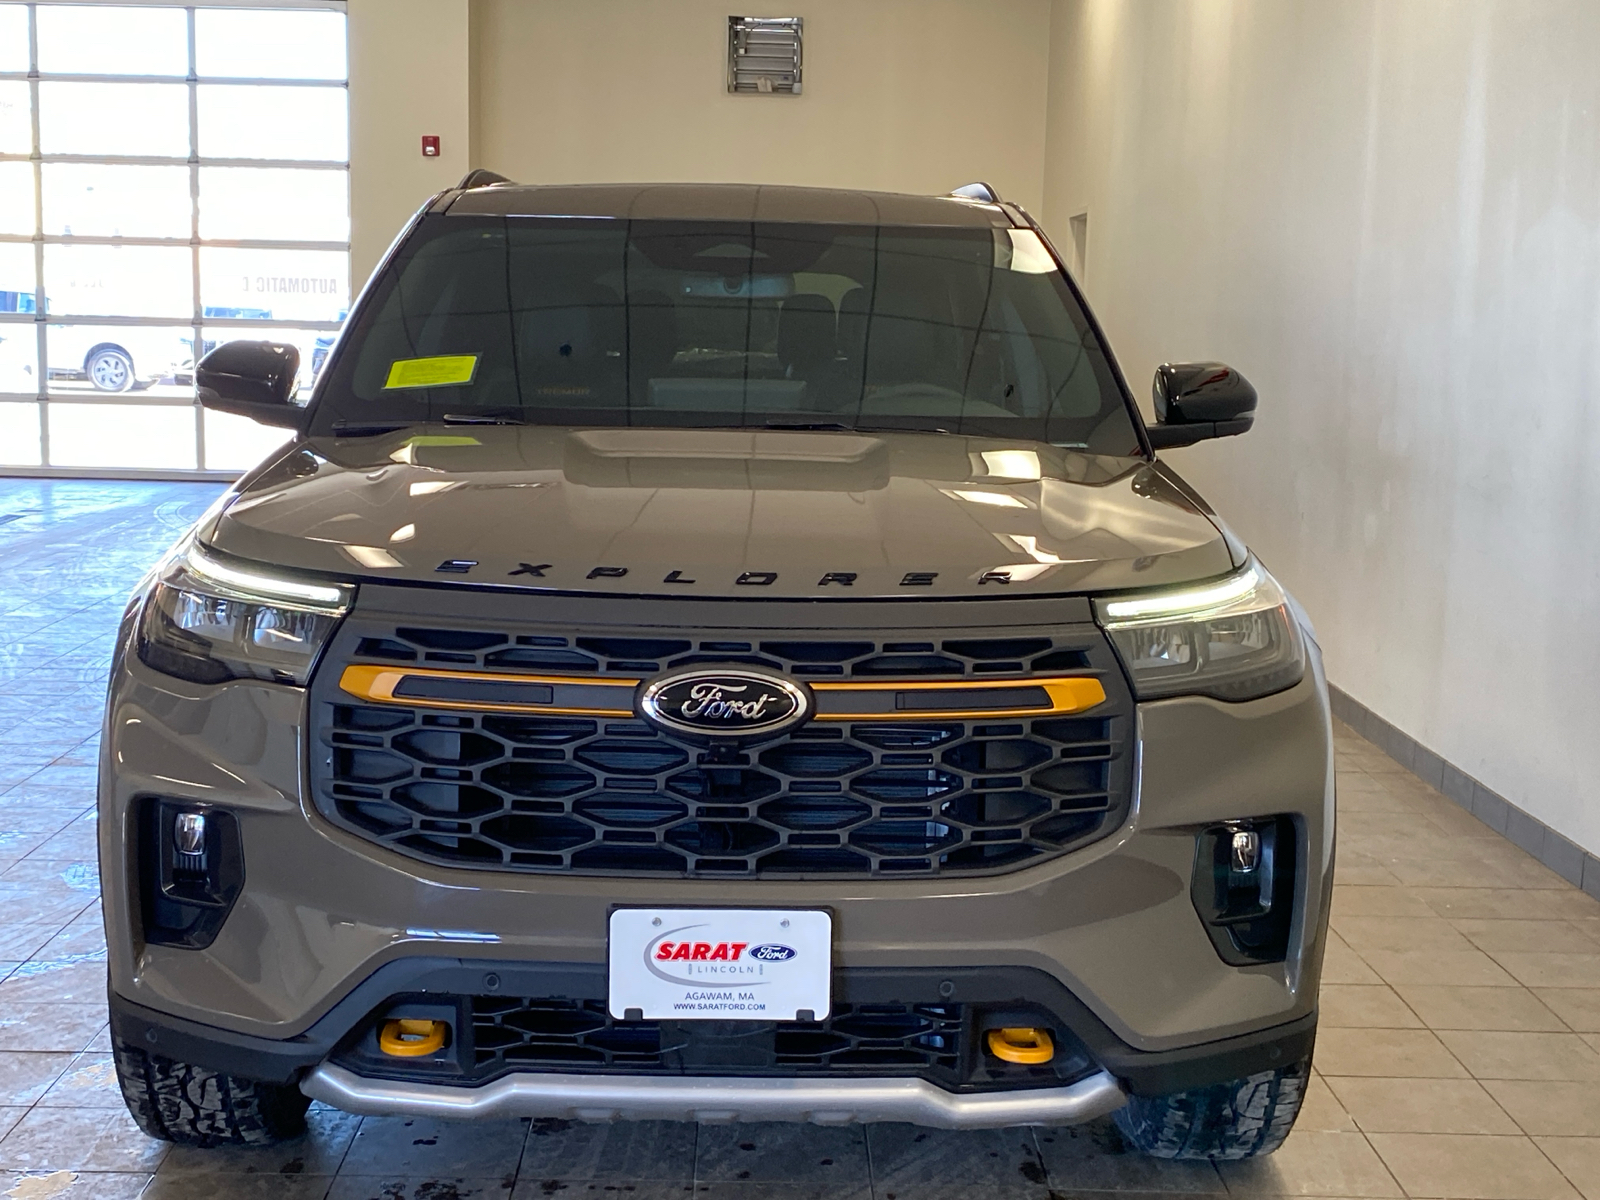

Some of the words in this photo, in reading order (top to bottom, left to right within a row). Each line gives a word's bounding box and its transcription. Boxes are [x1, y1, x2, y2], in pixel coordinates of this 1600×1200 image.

[436, 559, 1012, 586] EXPLORER
[680, 683, 777, 719] Ford
[654, 941, 748, 962] SARAT
[757, 947, 788, 961] Ford
[697, 966, 754, 974] LINCOLN
[685, 992, 735, 1001] AGAWAM,
[738, 992, 755, 1001] MA
[674, 1003, 766, 1011] WWW.SARATFORD.COM
